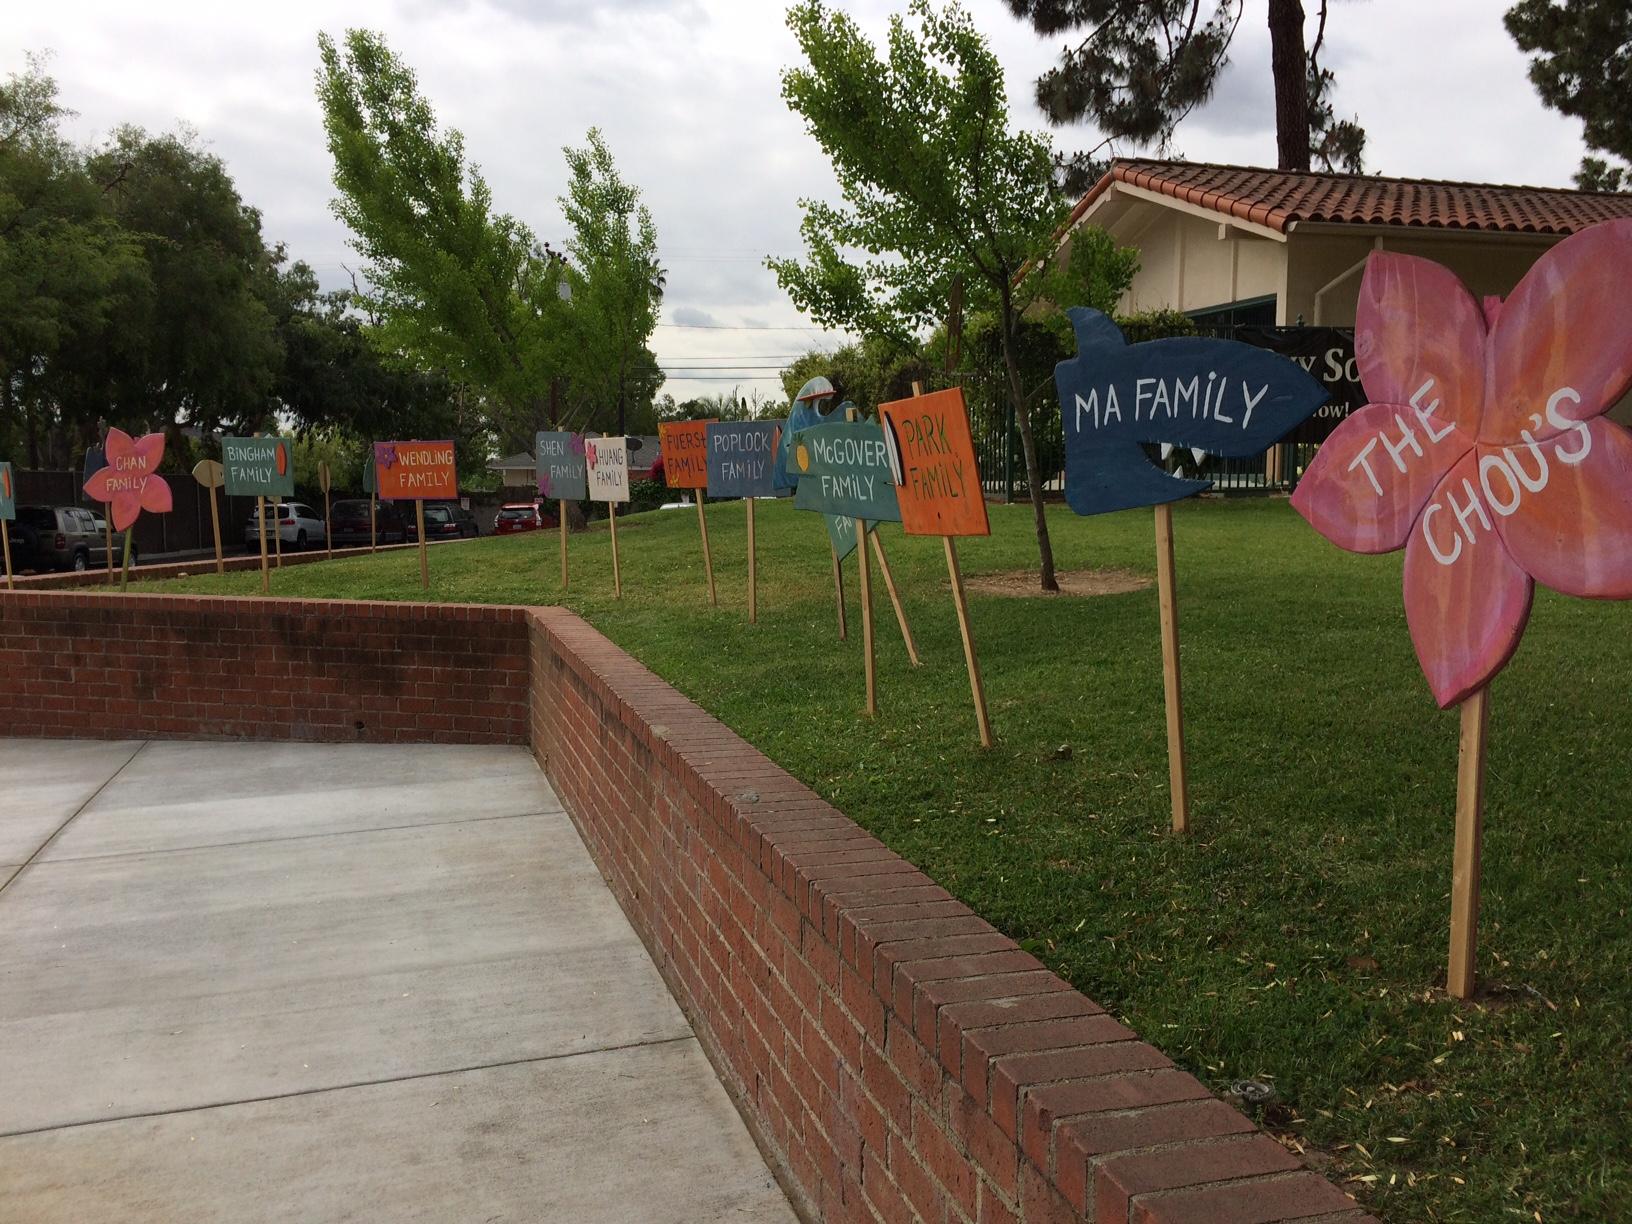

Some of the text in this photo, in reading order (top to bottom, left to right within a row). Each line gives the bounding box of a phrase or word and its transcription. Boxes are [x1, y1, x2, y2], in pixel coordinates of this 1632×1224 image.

[1075, 382, 1122, 433] MA
[540, 440, 565, 457] SHEN
[713, 431, 770, 453] POPLOCK
[902, 414, 952, 458] PARK
[1347, 378, 1456, 497] THE
[115, 455, 147, 471] CHAN
[598, 448, 624, 466] HUANG
[813, 437, 891, 469] McGOVER
[399, 471, 450, 488] FAMILY
[1422, 386, 1592, 566] CHOU'S
